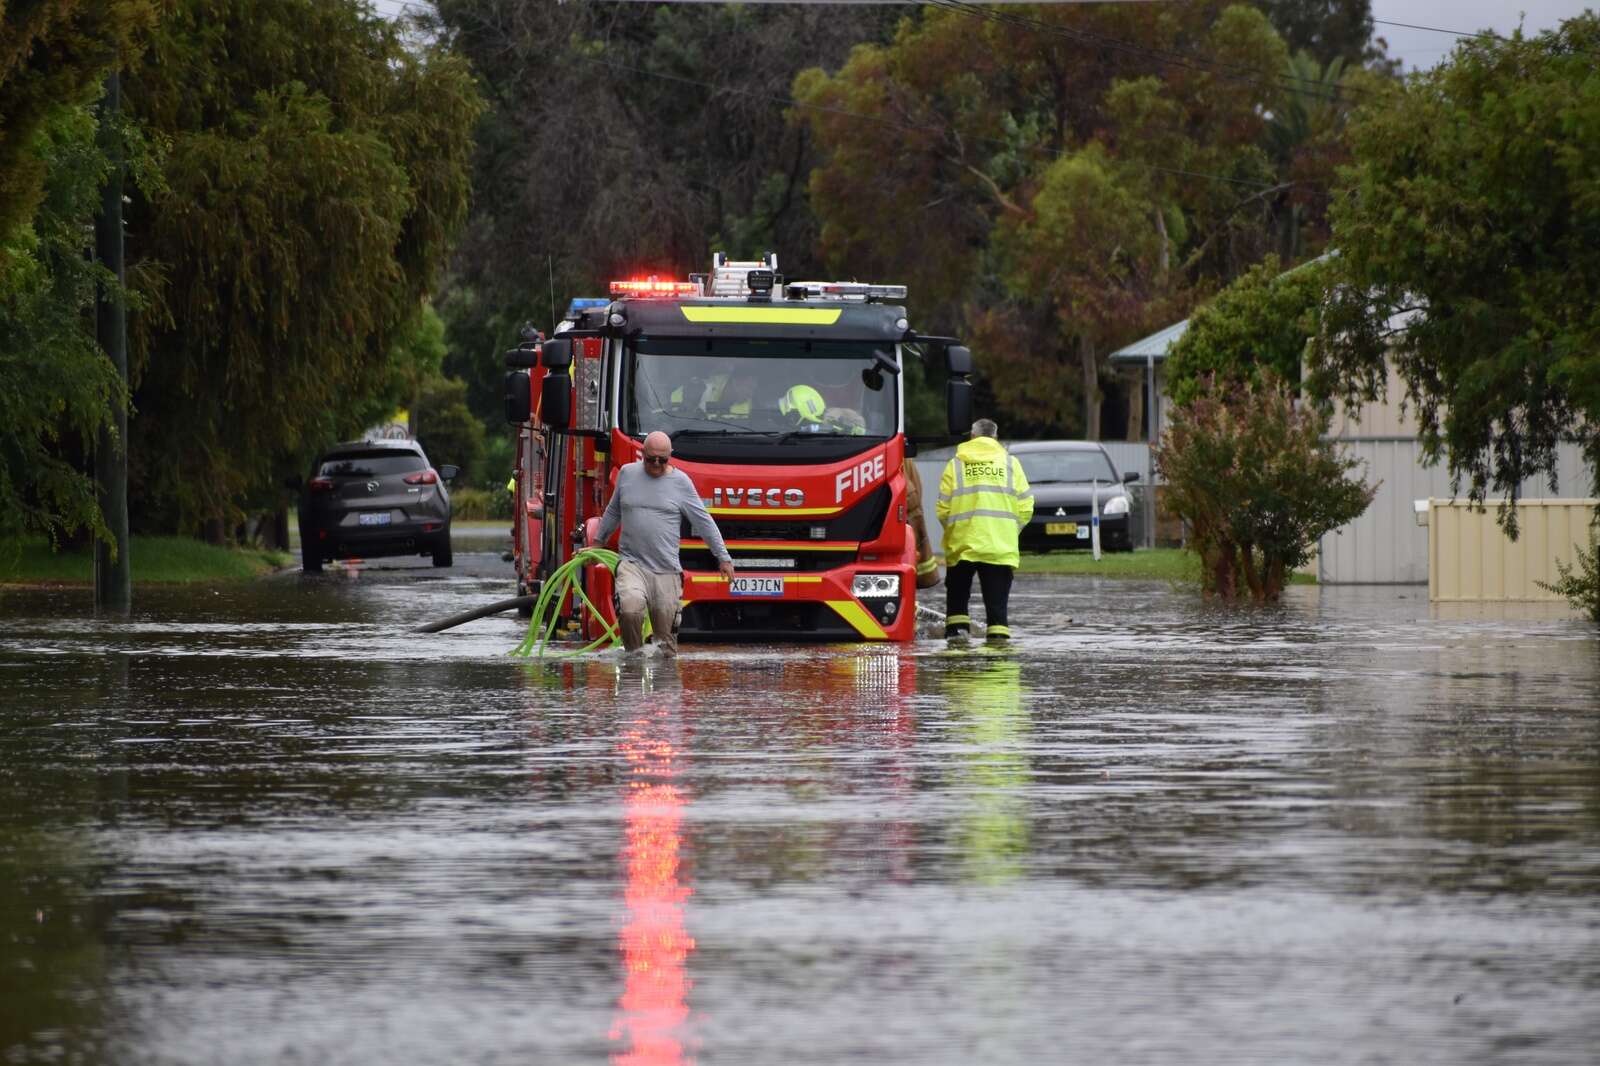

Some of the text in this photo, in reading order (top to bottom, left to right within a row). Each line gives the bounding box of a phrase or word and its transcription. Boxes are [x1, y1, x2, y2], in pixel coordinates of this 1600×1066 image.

[835, 454, 885, 504] FIRE
[965, 466, 1005, 477] RESCUE
[713, 487, 805, 507] IVECO
